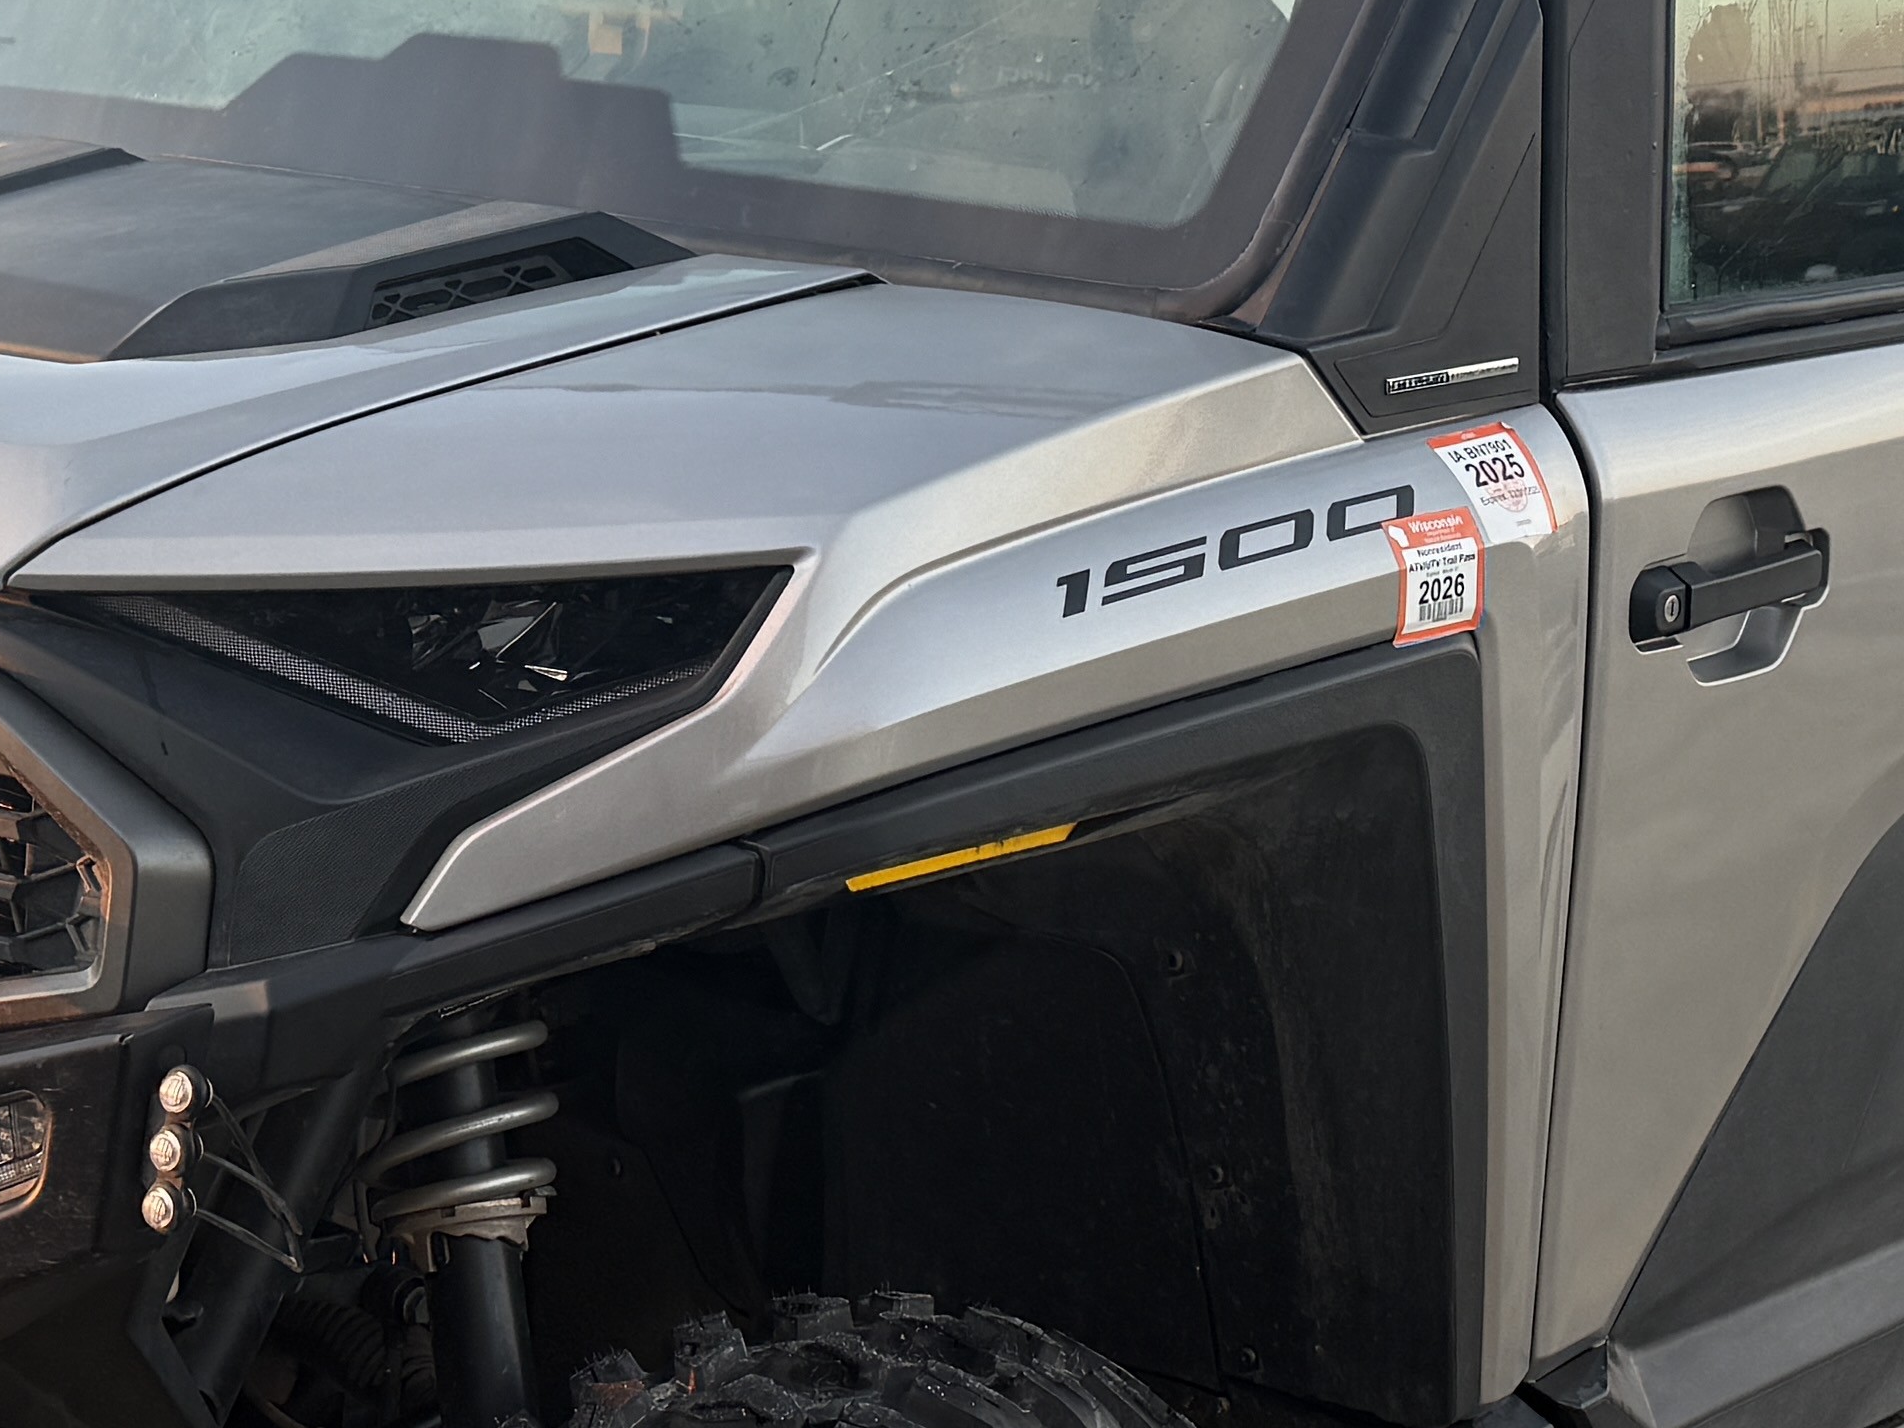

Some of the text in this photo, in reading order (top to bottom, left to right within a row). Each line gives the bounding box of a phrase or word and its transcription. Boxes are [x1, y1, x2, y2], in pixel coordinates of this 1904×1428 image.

[1448, 450, 1464, 463] IA
[1465, 453, 1525, 488] 2025
[1408, 513, 1464, 534] Wisconsin
[1056, 484, 1415, 619] 1500
[1418, 573, 1465, 605] 2026
